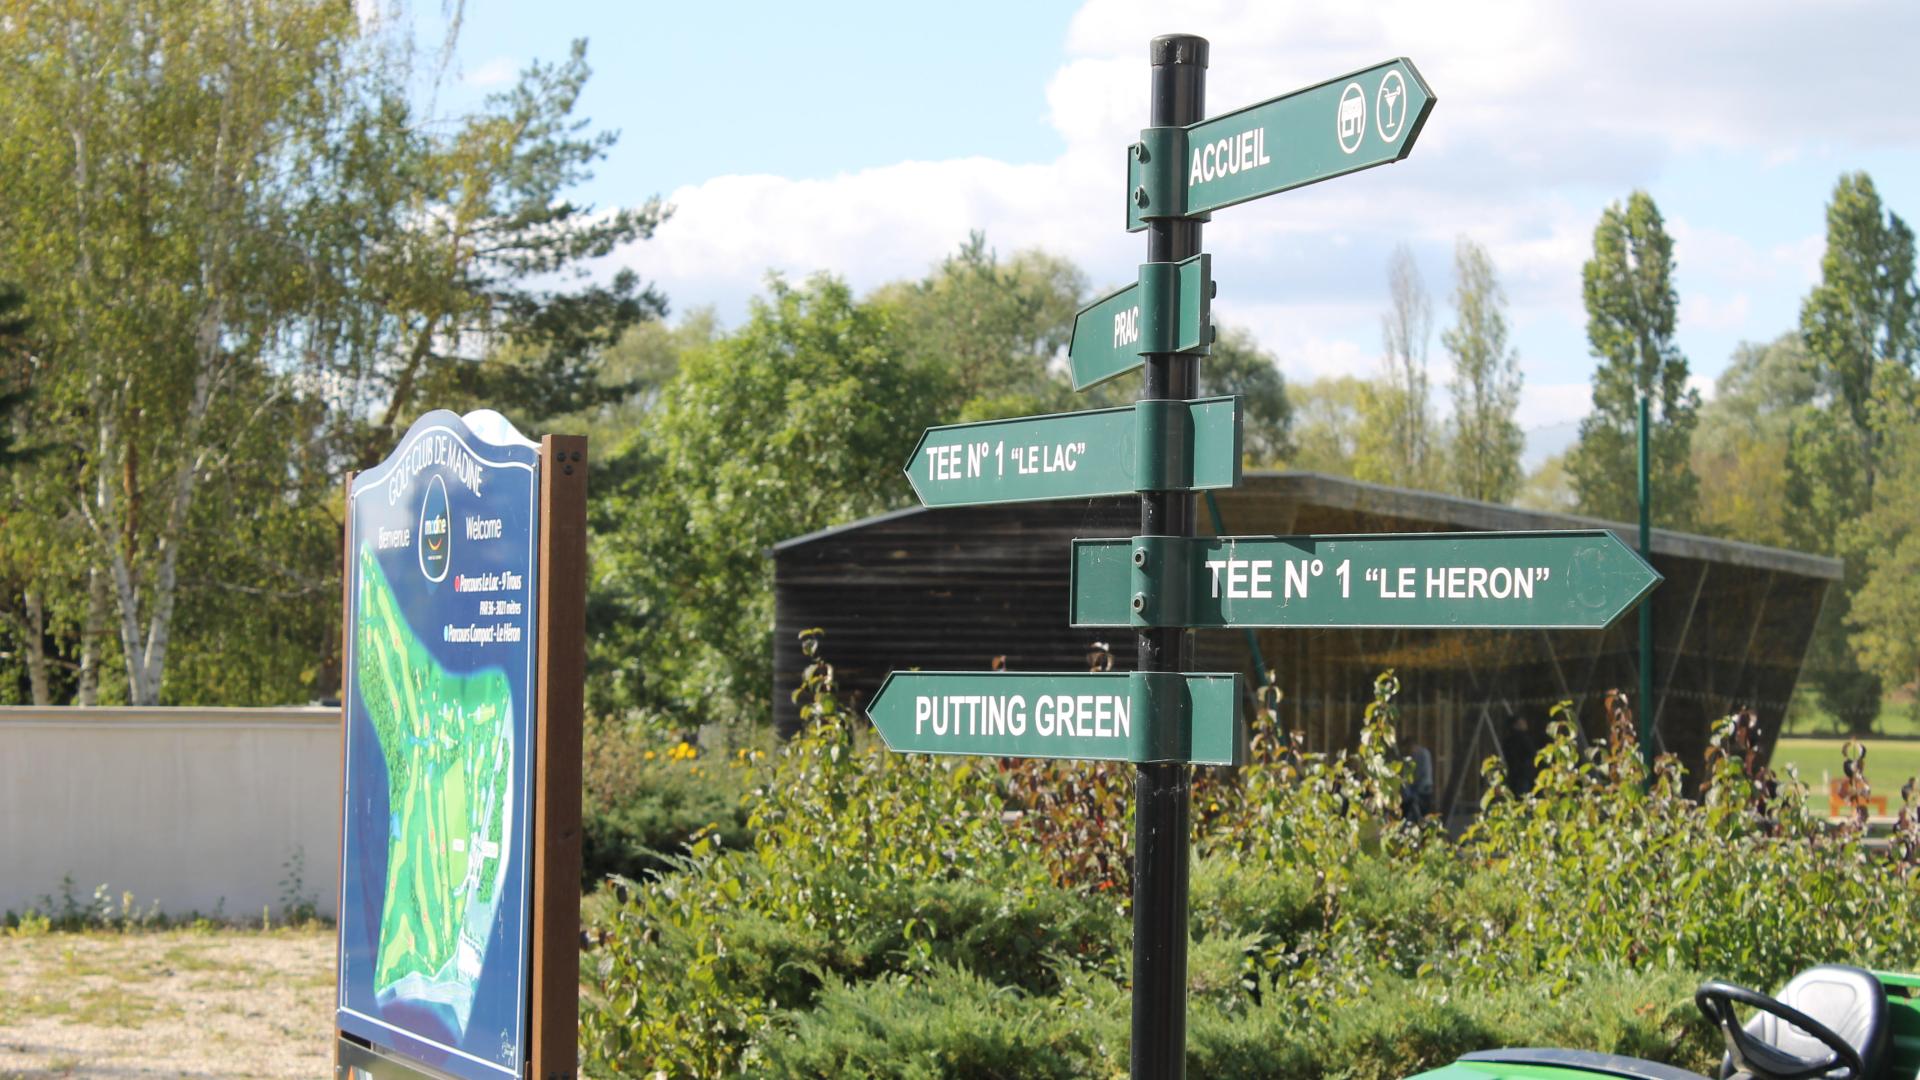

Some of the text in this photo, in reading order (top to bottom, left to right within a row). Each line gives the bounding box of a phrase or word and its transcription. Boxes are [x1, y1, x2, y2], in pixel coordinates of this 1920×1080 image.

[1189, 127, 1271, 187] ACCUEIL
[1114, 305, 1139, 349] PRAC
[388, 435, 483, 507] GOLF CLUB DE MADINE
[926, 444, 962, 481] TEE
[995, 440, 1004, 476] 1
[378, 526, 410, 549] Bienvenue
[465, 514, 502, 540] Welcome
[460, 573, 482, 592] Parcours
[482, 572, 489, 591] Le
[1205, 559, 1273, 598] TEE
[1335, 559, 1350, 598] 1
[448, 623, 470, 642] Parcours
[496, 622, 503, 642] Le
[915, 694, 1131, 738] PUTTING GREEN
